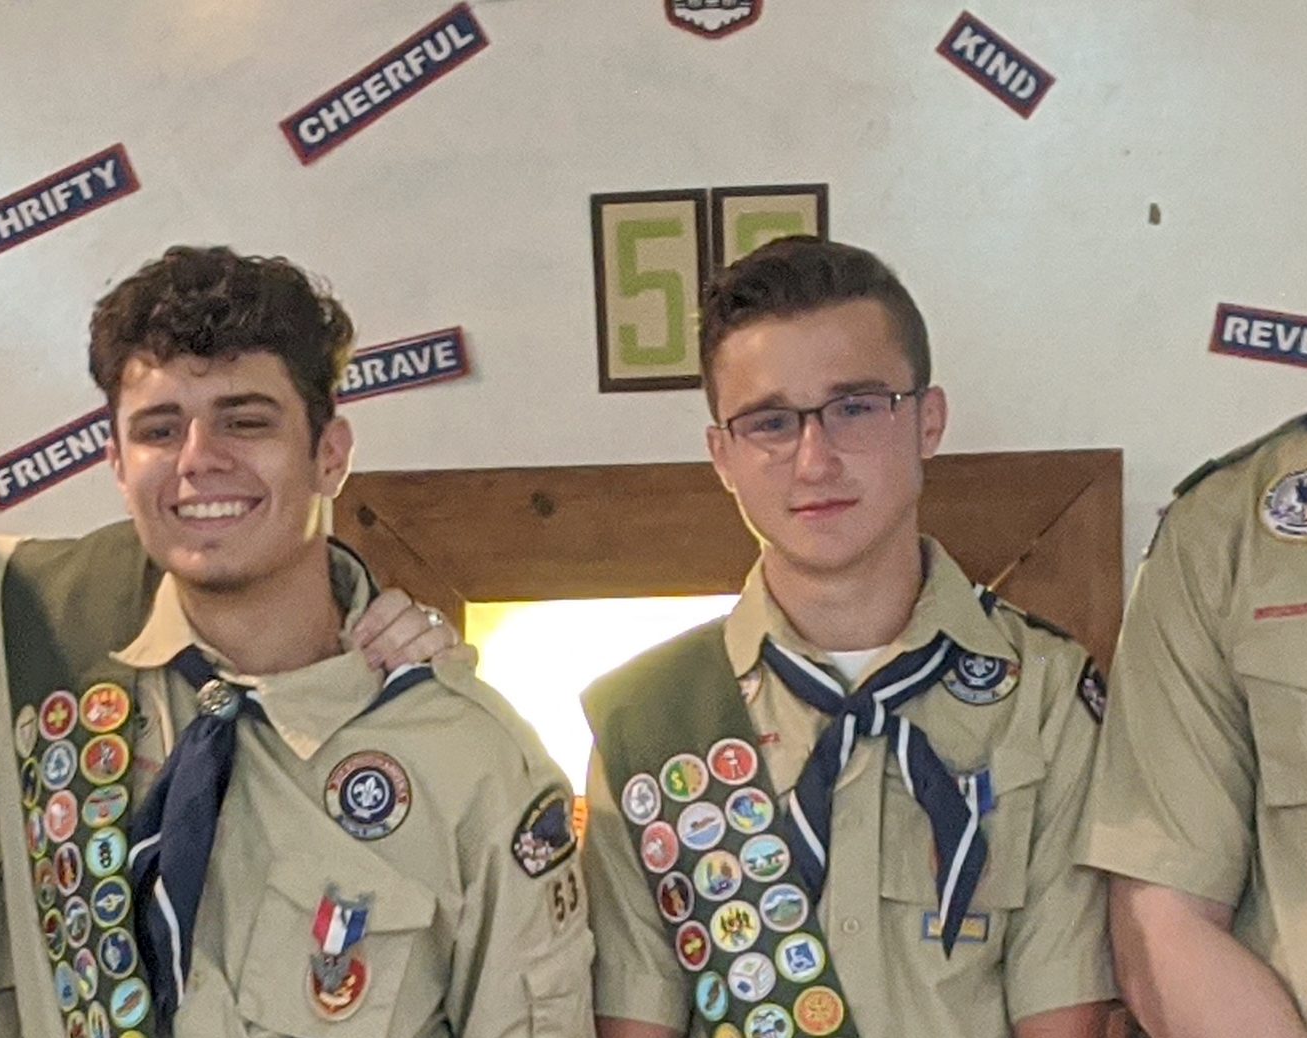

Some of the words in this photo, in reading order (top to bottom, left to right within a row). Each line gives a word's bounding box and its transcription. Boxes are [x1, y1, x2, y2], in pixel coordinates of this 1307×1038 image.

[298, 23, 475, 145] CHEERFUL
[951, 25, 1037, 99] KIND
[340, 340, 458, 392] BRAVE
[553, 871, 578, 922] 53
